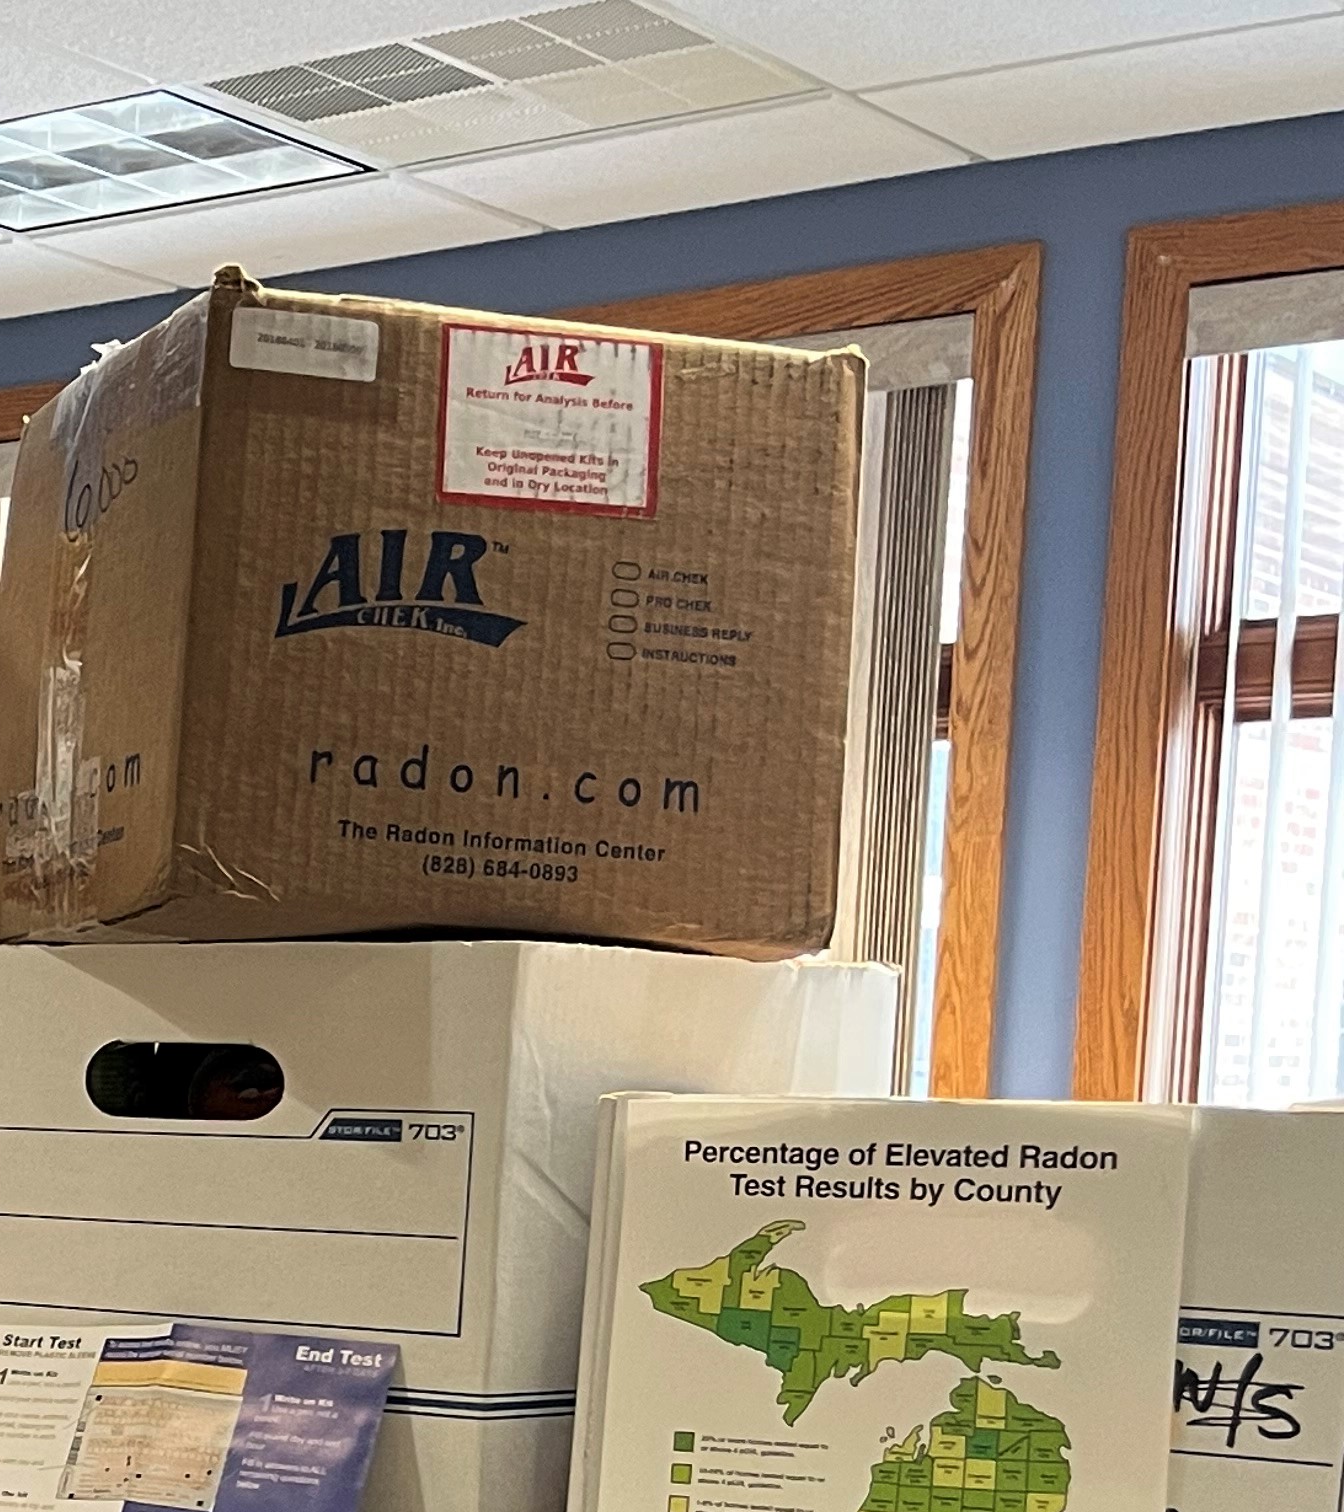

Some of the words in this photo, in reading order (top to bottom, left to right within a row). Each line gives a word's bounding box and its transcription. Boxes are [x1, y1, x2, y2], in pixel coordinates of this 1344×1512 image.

[513, 344, 581, 376] AIR
[466, 387, 510, 401] Return
[514, 391, 532, 403] for
[535, 392, 588, 409] Analysis
[592, 398, 634, 412] Before
[476, 446, 508, 461] Keep
[511, 450, 575, 468] Unopened
[579, 453, 605, 468] Kits
[608, 455, 620, 468] in
[487, 461, 538, 479] Original
[541, 465, 607, 484] Packaging
[484, 475, 508, 489] and
[511, 476, 524, 490] in
[527, 478, 552, 495] Dry
[553, 480, 609, 497] Location
[296, 529, 489, 616] AIR
[646, 595, 672, 609] PRO
[676, 598, 712, 612] CHEK
[357, 604, 430, 628] CHEK
[644, 621, 709, 639] BUSINESS
[712, 627, 753, 642] REPLY
[641, 648, 737, 667] INSTRUCTIONS
[309, 744, 700, 814] radon.com
[338, 819, 378, 841] The
[386, 825, 455, 847] Radon
[463, 829, 587, 858] Information
[596, 841, 666, 862] Center
[422, 854, 475, 880] (828)
[483, 857, 579, 883] 684-0893
[684, 1140, 840, 1171] Percentage
[848, 1142, 878, 1167] of
[886, 1142, 1009, 1168] Elevated
[1019, 1144, 1119, 1170] Radon
[730, 1173, 786, 1198] Test
[795, 1175, 900, 1201] Results
[910, 1177, 945, 1207] by
[954, 1178, 1063, 1209] County
[2, 1333, 44, 1349] Start
[49, 1335, 82, 1350] Test
[1179, 1325, 1245, 1341] OR/FILE
[295, 1345, 333, 1364] End
[339, 1349, 382, 1369] Test
